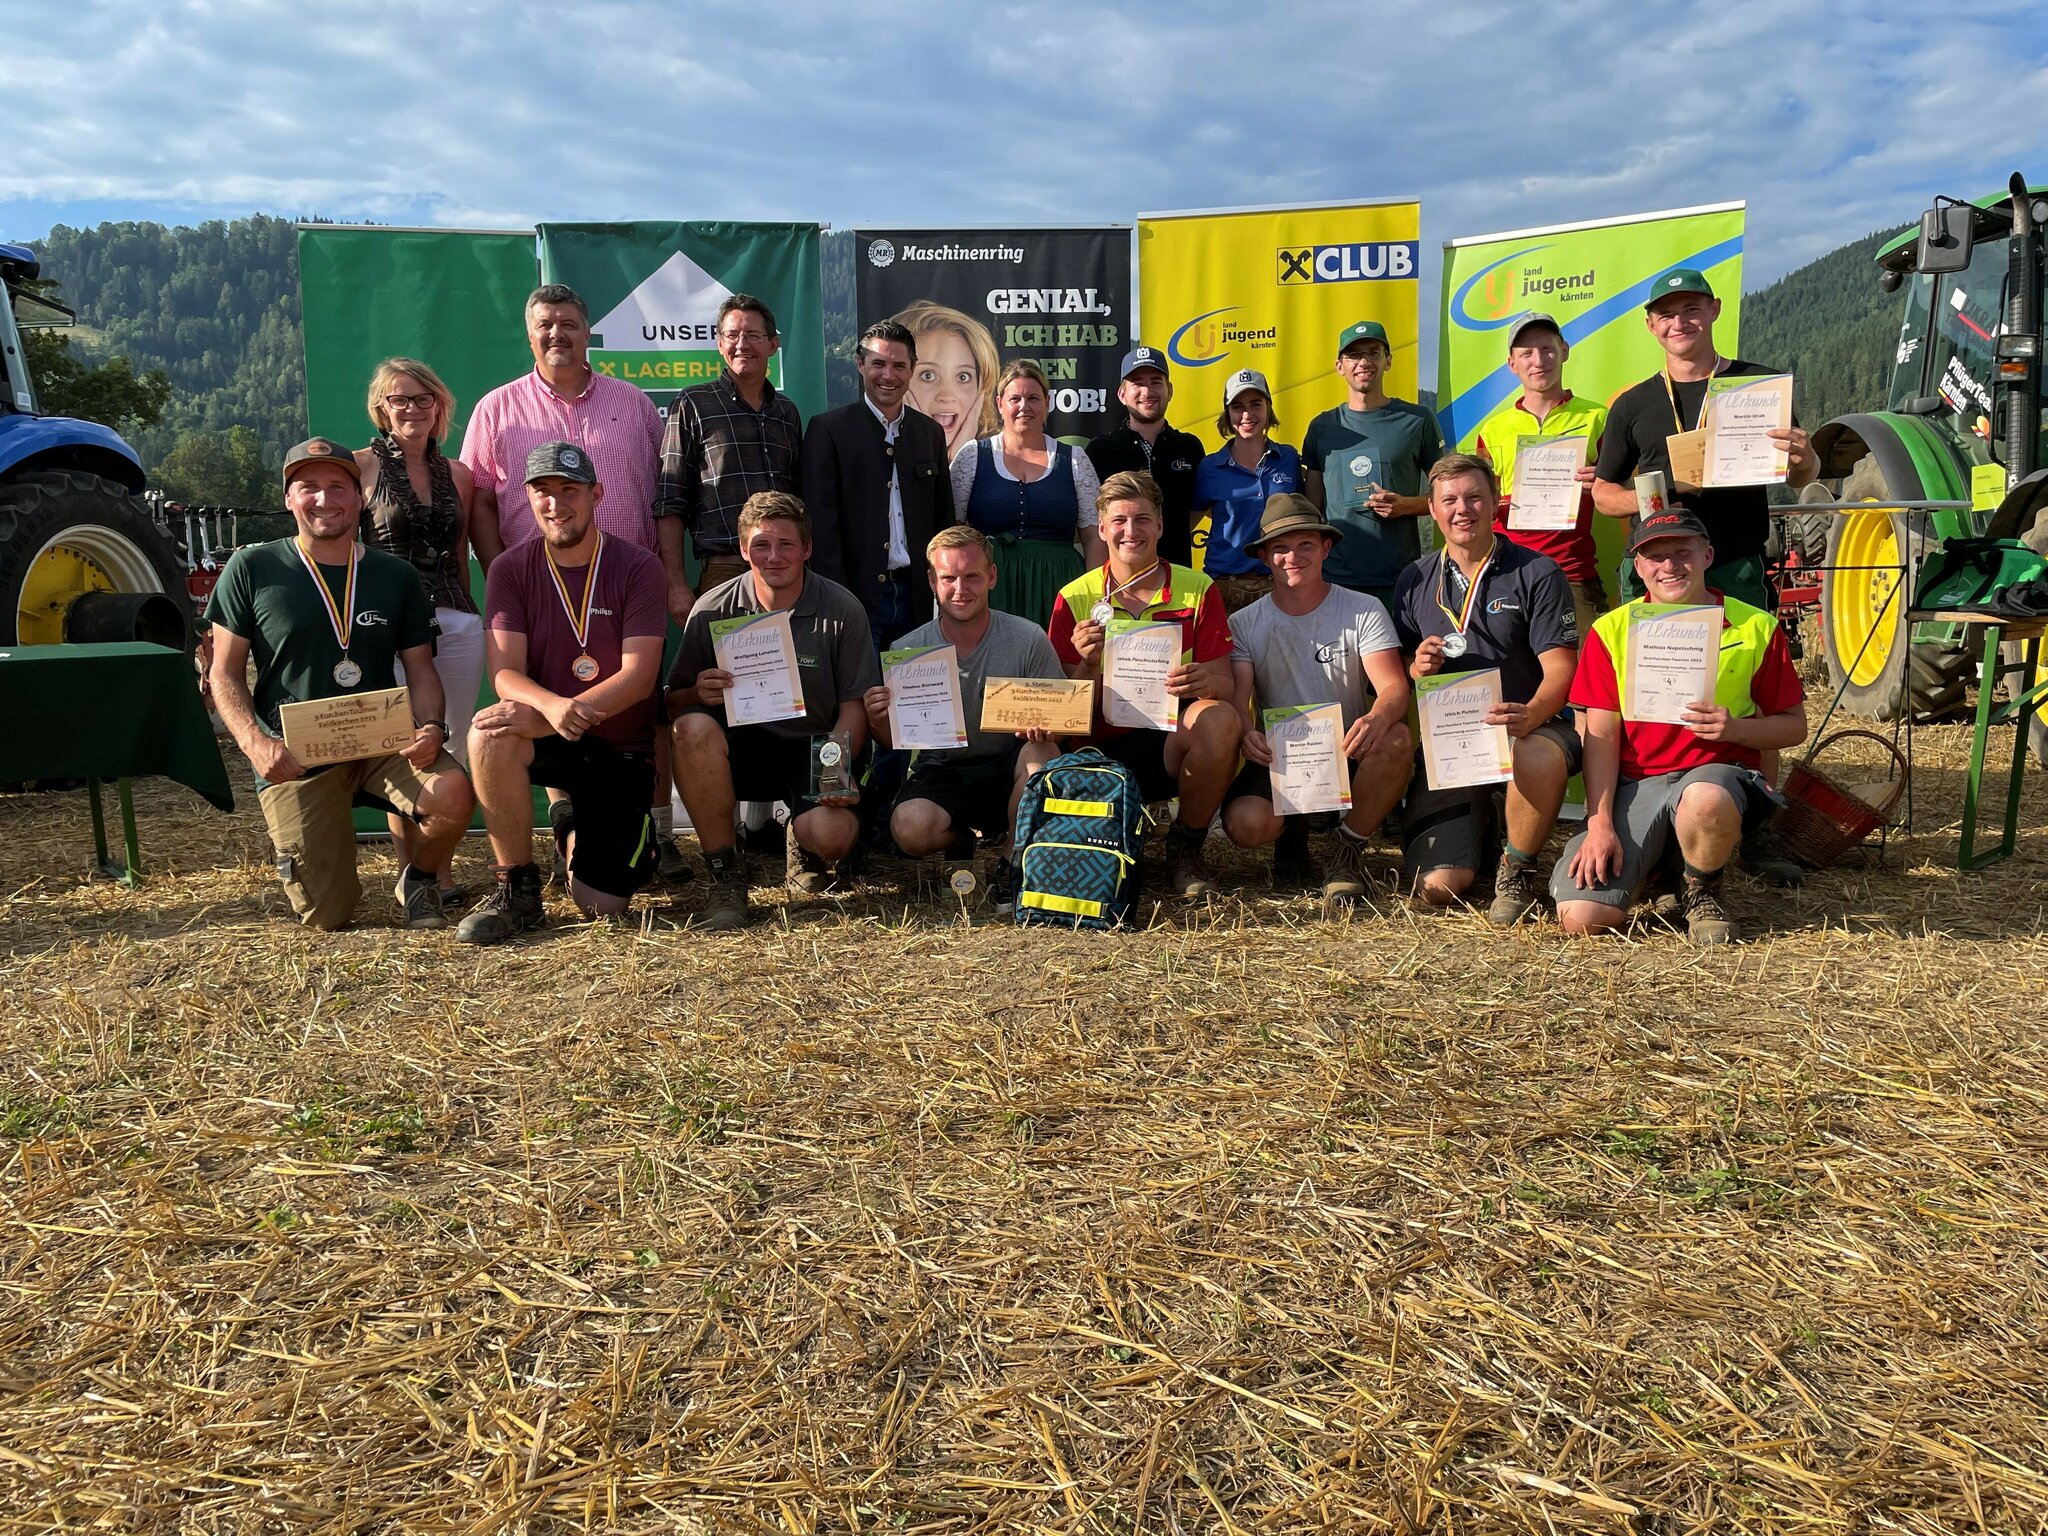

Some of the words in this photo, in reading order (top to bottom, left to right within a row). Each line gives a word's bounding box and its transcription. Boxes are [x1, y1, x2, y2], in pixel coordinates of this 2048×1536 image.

[902, 244, 1024, 264] Maschinenring
[1315, 245, 1412, 280] CLUB
[1524, 266, 1542, 276] land
[1522, 270, 1595, 296] jugend
[986, 288, 1111, 317] GENIAL,
[1560, 291, 1594, 302] kärnten
[1005, 325, 1055, 347] ICH
[1057, 325, 1118, 347] HAB
[1222, 327, 1276, 343] jugend
[1251, 341, 1276, 349] kärnten
[1939, 371, 1968, 411] Kärnten
[1948, 355, 1992, 413] PflügerTea
[1719, 392, 1780, 408] Urkunde
[1525, 449, 1576, 462] Urkunde
[723, 628, 780, 649] Urkunde
[1639, 621, 1708, 639] Urkunde
[1114, 635, 1172, 653] Urkunde
[892, 661, 948, 679] Urkunde
[1427, 686, 1491, 706] Urkunde
[318, 717, 359, 728] Feldkirchen
[1273, 719, 1333, 738] Urkunde
[1087, 837, 1119, 847] BURTON
